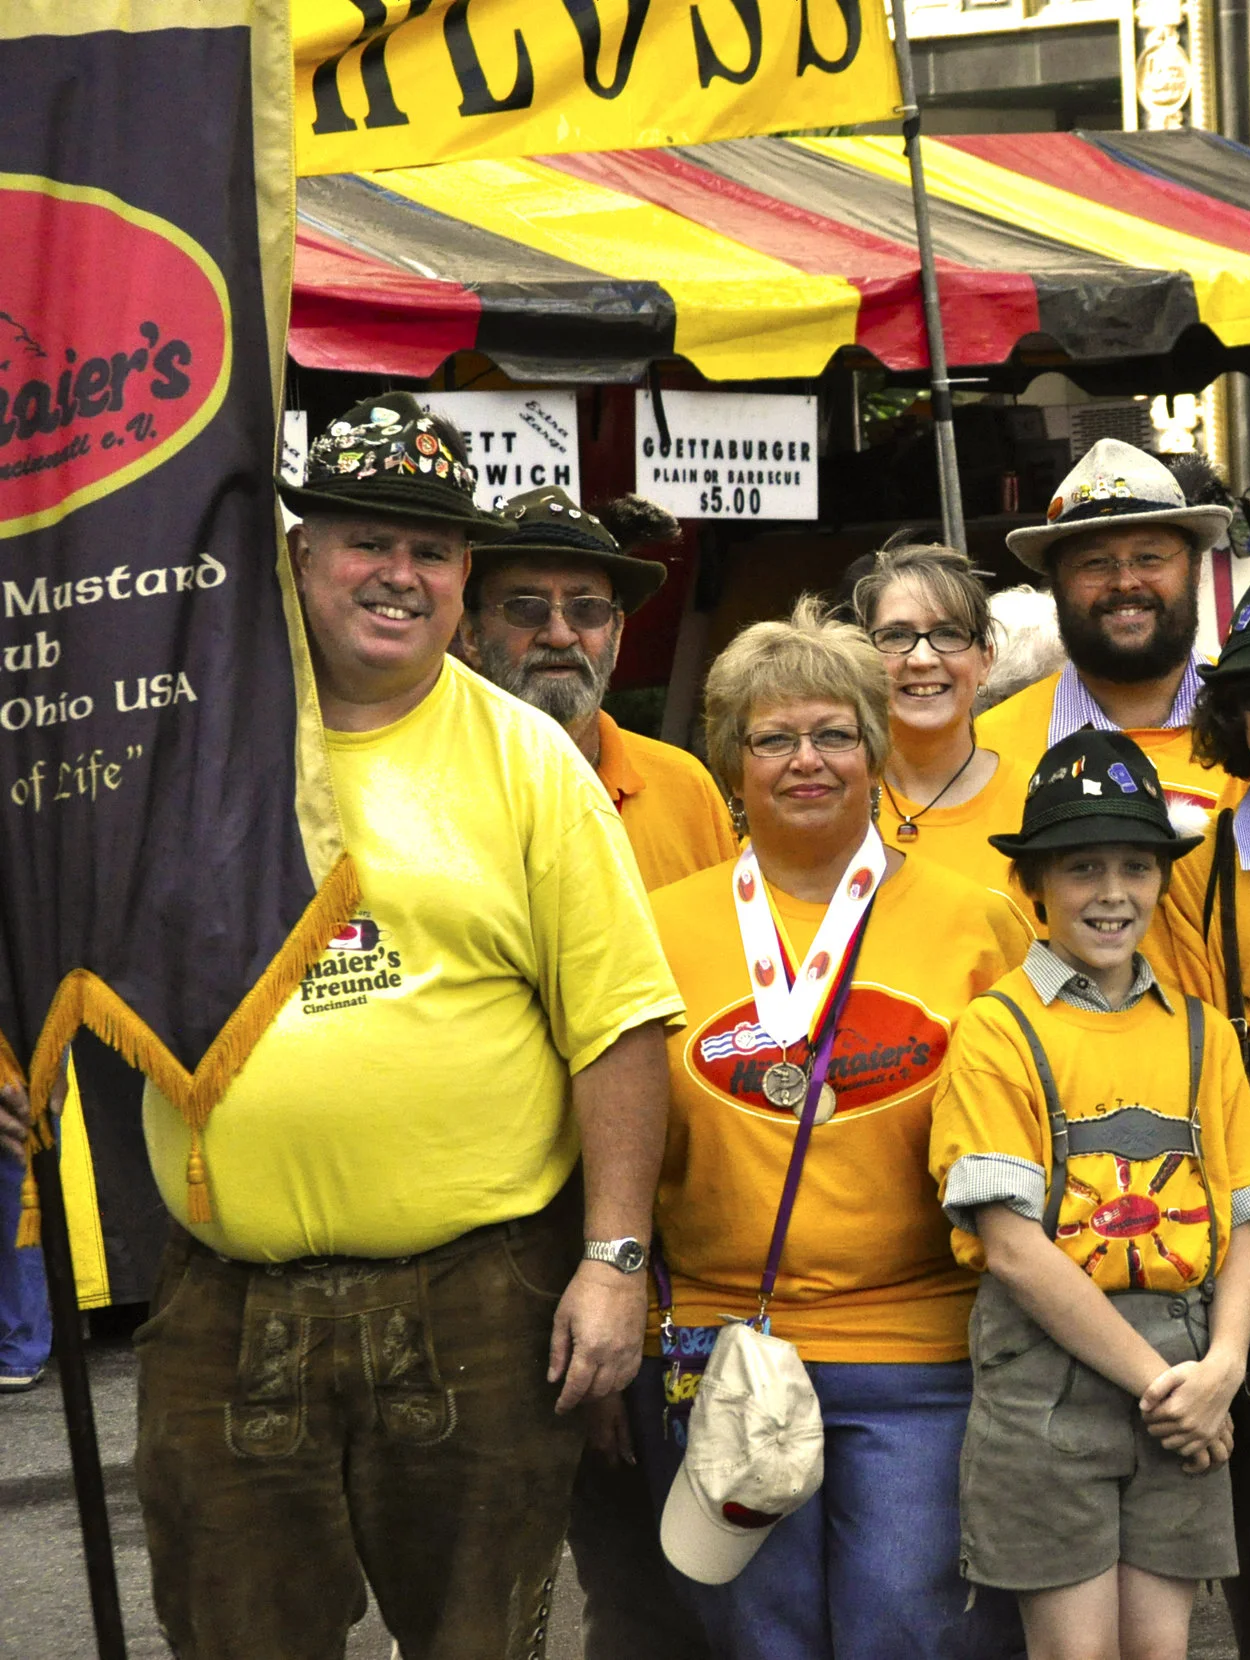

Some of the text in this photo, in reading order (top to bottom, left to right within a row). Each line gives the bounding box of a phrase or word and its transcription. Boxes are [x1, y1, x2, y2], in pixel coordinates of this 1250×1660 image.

[642, 436, 811, 462] GOETTABURGER
[653, 468, 801, 486] PLAIN OR BARBECUE
[700, 486, 761, 514] $5.00
[2, 553, 227, 618] Mustard
[0, 631, 61, 673] ub
[0, 672, 198, 731] Ohio USA
[10, 760, 46, 813] of
[299, 970, 402, 1001] Freunde
[303, 995, 368, 1015] Cincinnati
